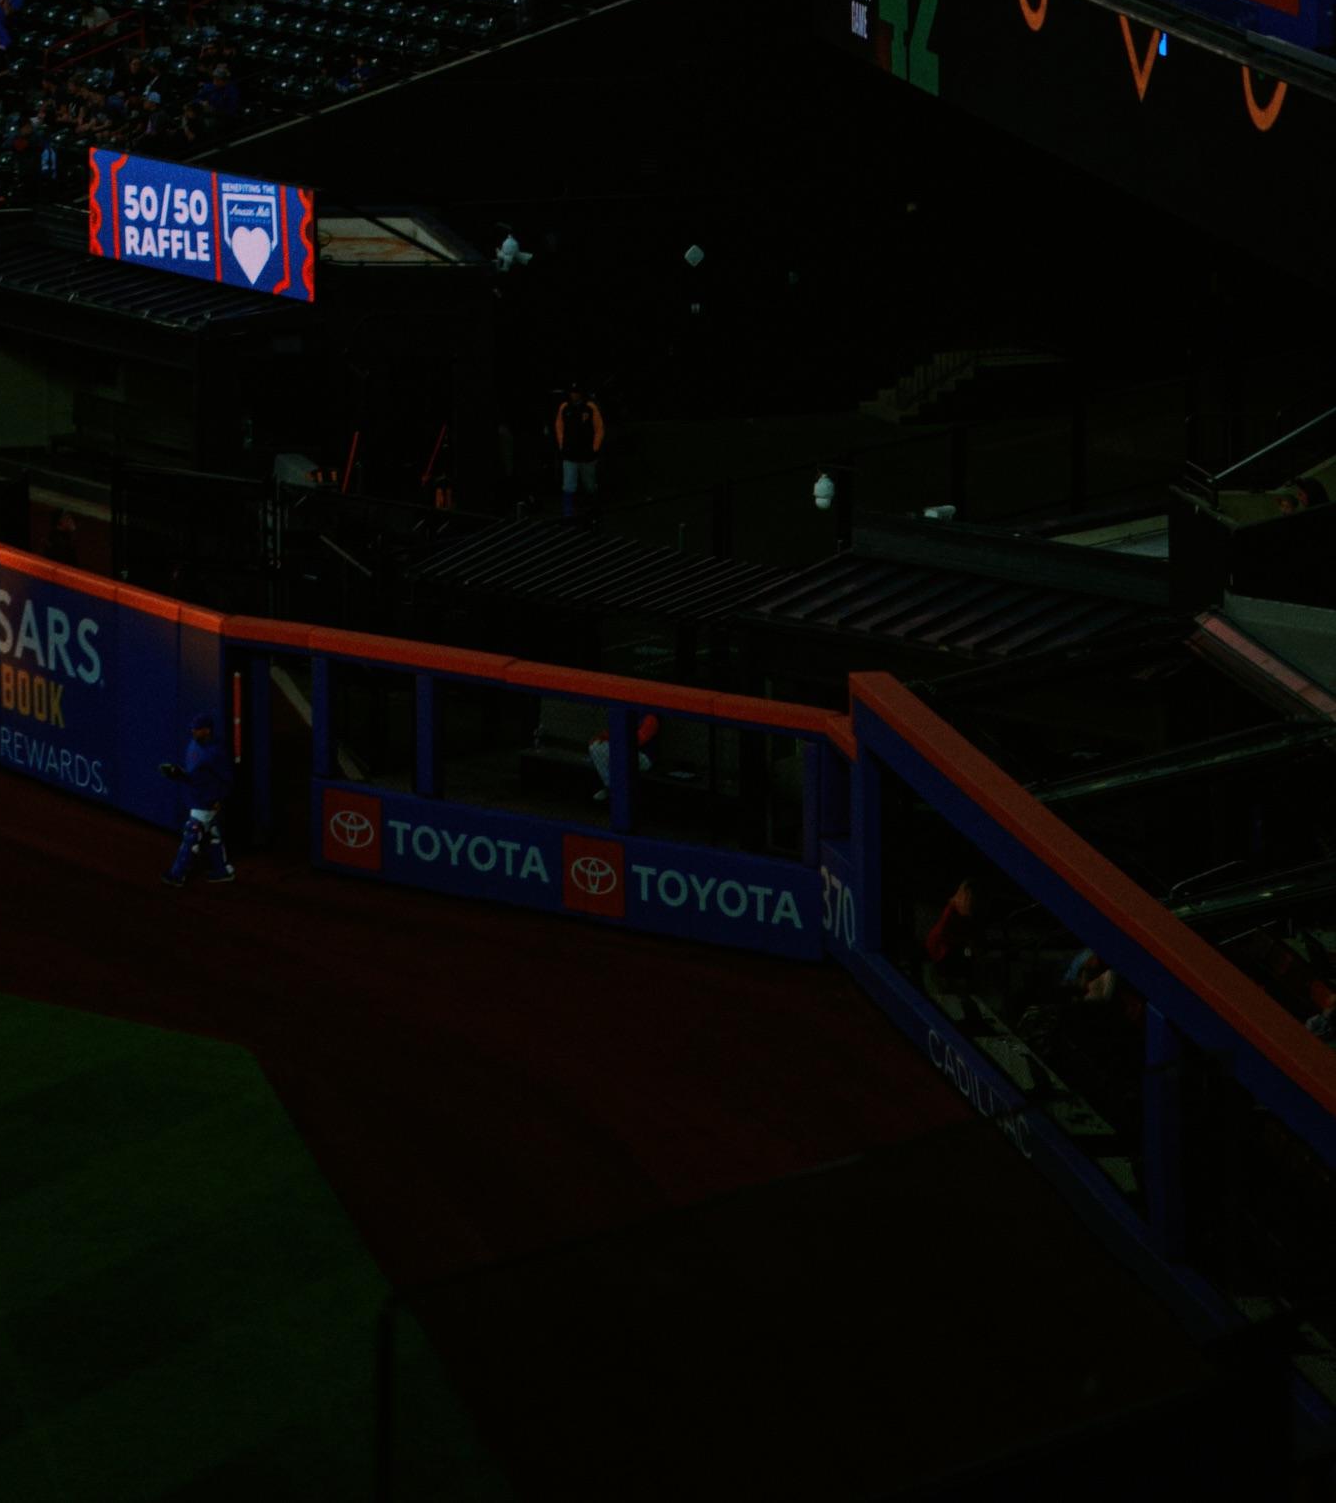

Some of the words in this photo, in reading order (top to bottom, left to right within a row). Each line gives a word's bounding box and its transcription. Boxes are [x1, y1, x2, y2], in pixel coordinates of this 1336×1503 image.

[124, 183, 209, 228] 50/50
[125, 226, 211, 262] RAFFLE
[389, 819, 550, 883] TOYOTA
[632, 864, 803, 929] TOYOTA
[820, 864, 856, 949] 370
